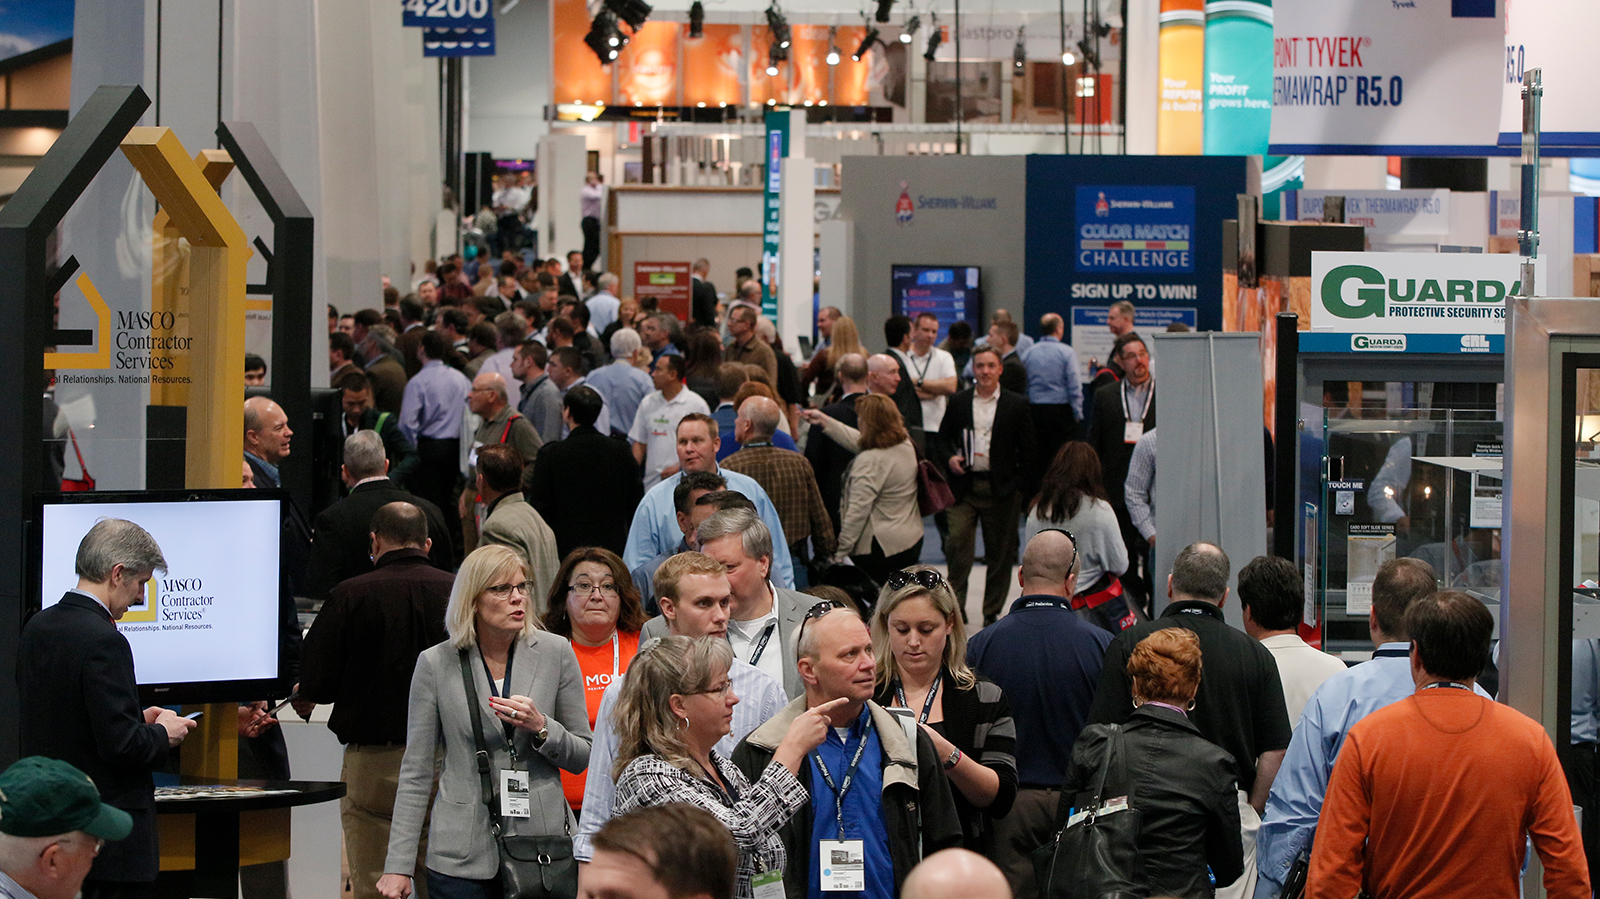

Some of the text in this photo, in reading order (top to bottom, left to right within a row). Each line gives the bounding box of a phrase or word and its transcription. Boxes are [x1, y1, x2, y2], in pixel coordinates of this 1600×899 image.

[403, 0, 489, 19] 4200
[1208, 73, 1235, 83] Your
[1209, 84, 1249, 96] PROFIT
[1356, 75, 1403, 107] R5.0
[1208, 98, 1242, 110] grows
[1080, 223, 1190, 240] COLOR MATCH
[1080, 250, 1190, 267] CHALLENGE
[1071, 283, 1198, 300] SIGN UP TO WIN!
[1389, 306, 1446, 317] PROTECTIVE
[1447, 307, 1493, 318] SECURITY
[117, 310, 175, 331] MASCO
[115, 331, 194, 350] Contractor
[1354, 336, 1404, 349] GUARDA
[115, 351, 176, 370] Services
[63, 374, 117, 385] Relationships.
[118, 374, 150, 384] National
[152, 374, 193, 384] Resources.
[162, 578, 202, 592] MASCO
[161, 594, 214, 608] Contractor
[162, 608, 203, 621] Services
[184, 623, 214, 631] Resources.
